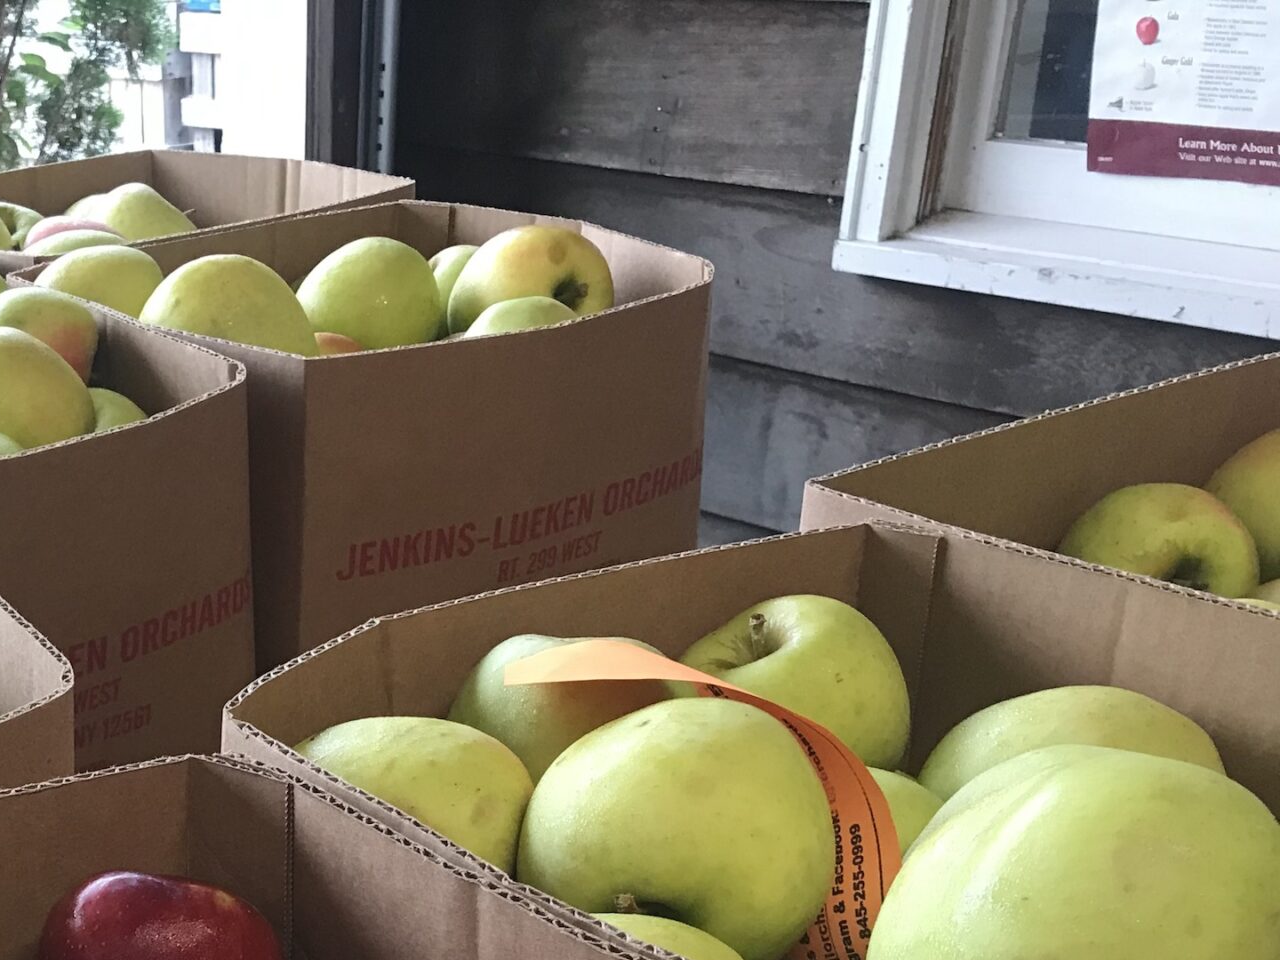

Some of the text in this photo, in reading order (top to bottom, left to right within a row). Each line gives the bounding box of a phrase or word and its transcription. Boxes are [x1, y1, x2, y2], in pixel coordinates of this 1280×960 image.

[1179, 137, 1274, 155] Learn More About
[1214, 154, 1232, 163] Web
[336, 448, 703, 582] JENKINS-LUEKEN ORCHARD
[496, 530, 603, 583] RT. 299 WEST
[120, 574, 251, 663] ORCHARD
[101, 703, 152, 742] 12561
[849, 822, 872, 940] 845-255-0999
[833, 900, 846, 915] &
